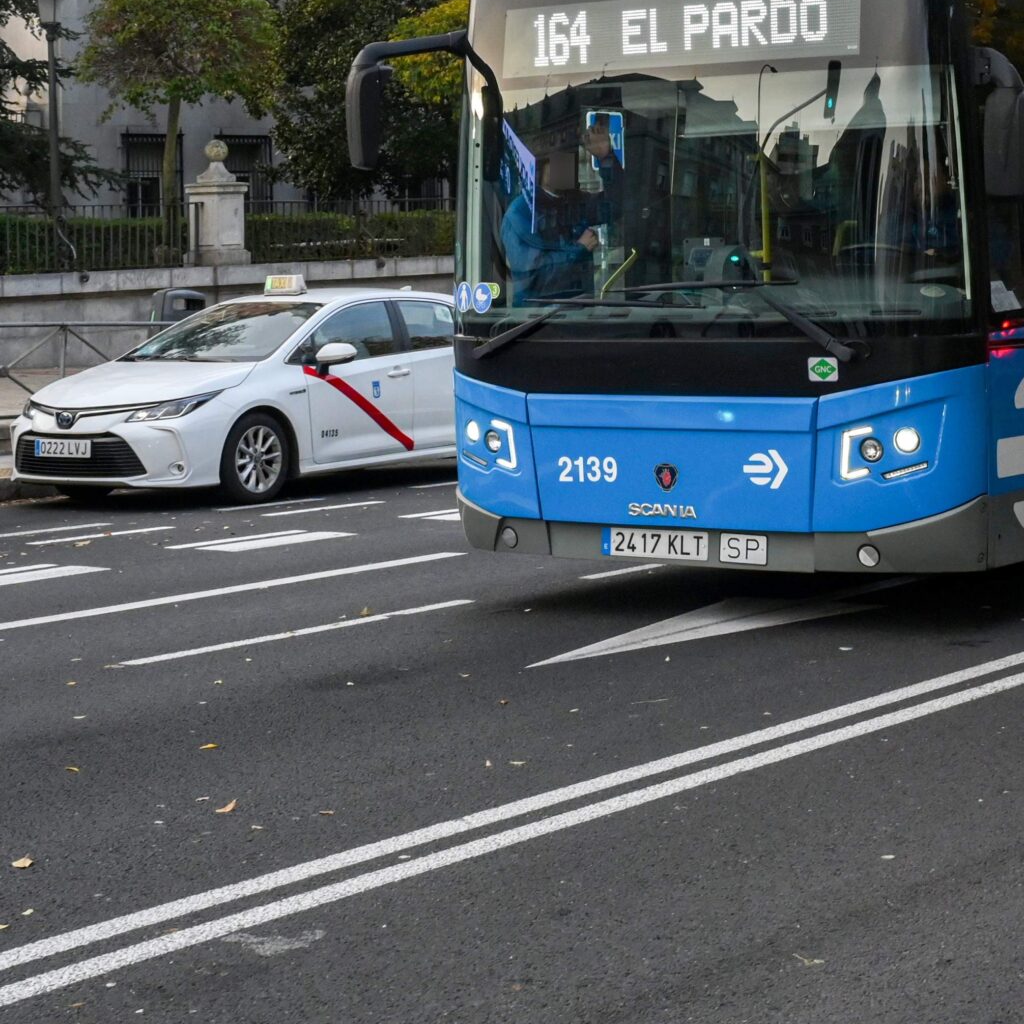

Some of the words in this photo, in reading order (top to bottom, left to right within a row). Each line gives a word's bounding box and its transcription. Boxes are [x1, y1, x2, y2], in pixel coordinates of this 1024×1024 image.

[534, 10, 590, 67] 164
[622, 8, 667, 55] EL
[814, 365, 832, 374] GNC
[41, 441, 65, 455] 0222
[67, 442, 87, 456] LVJ
[558, 456, 618, 483] 2139
[628, 502, 697, 519] SCANIA
[614, 531, 662, 554] 2417
[667, 534, 704, 557] KLT
[727, 537, 760, 560] SP
